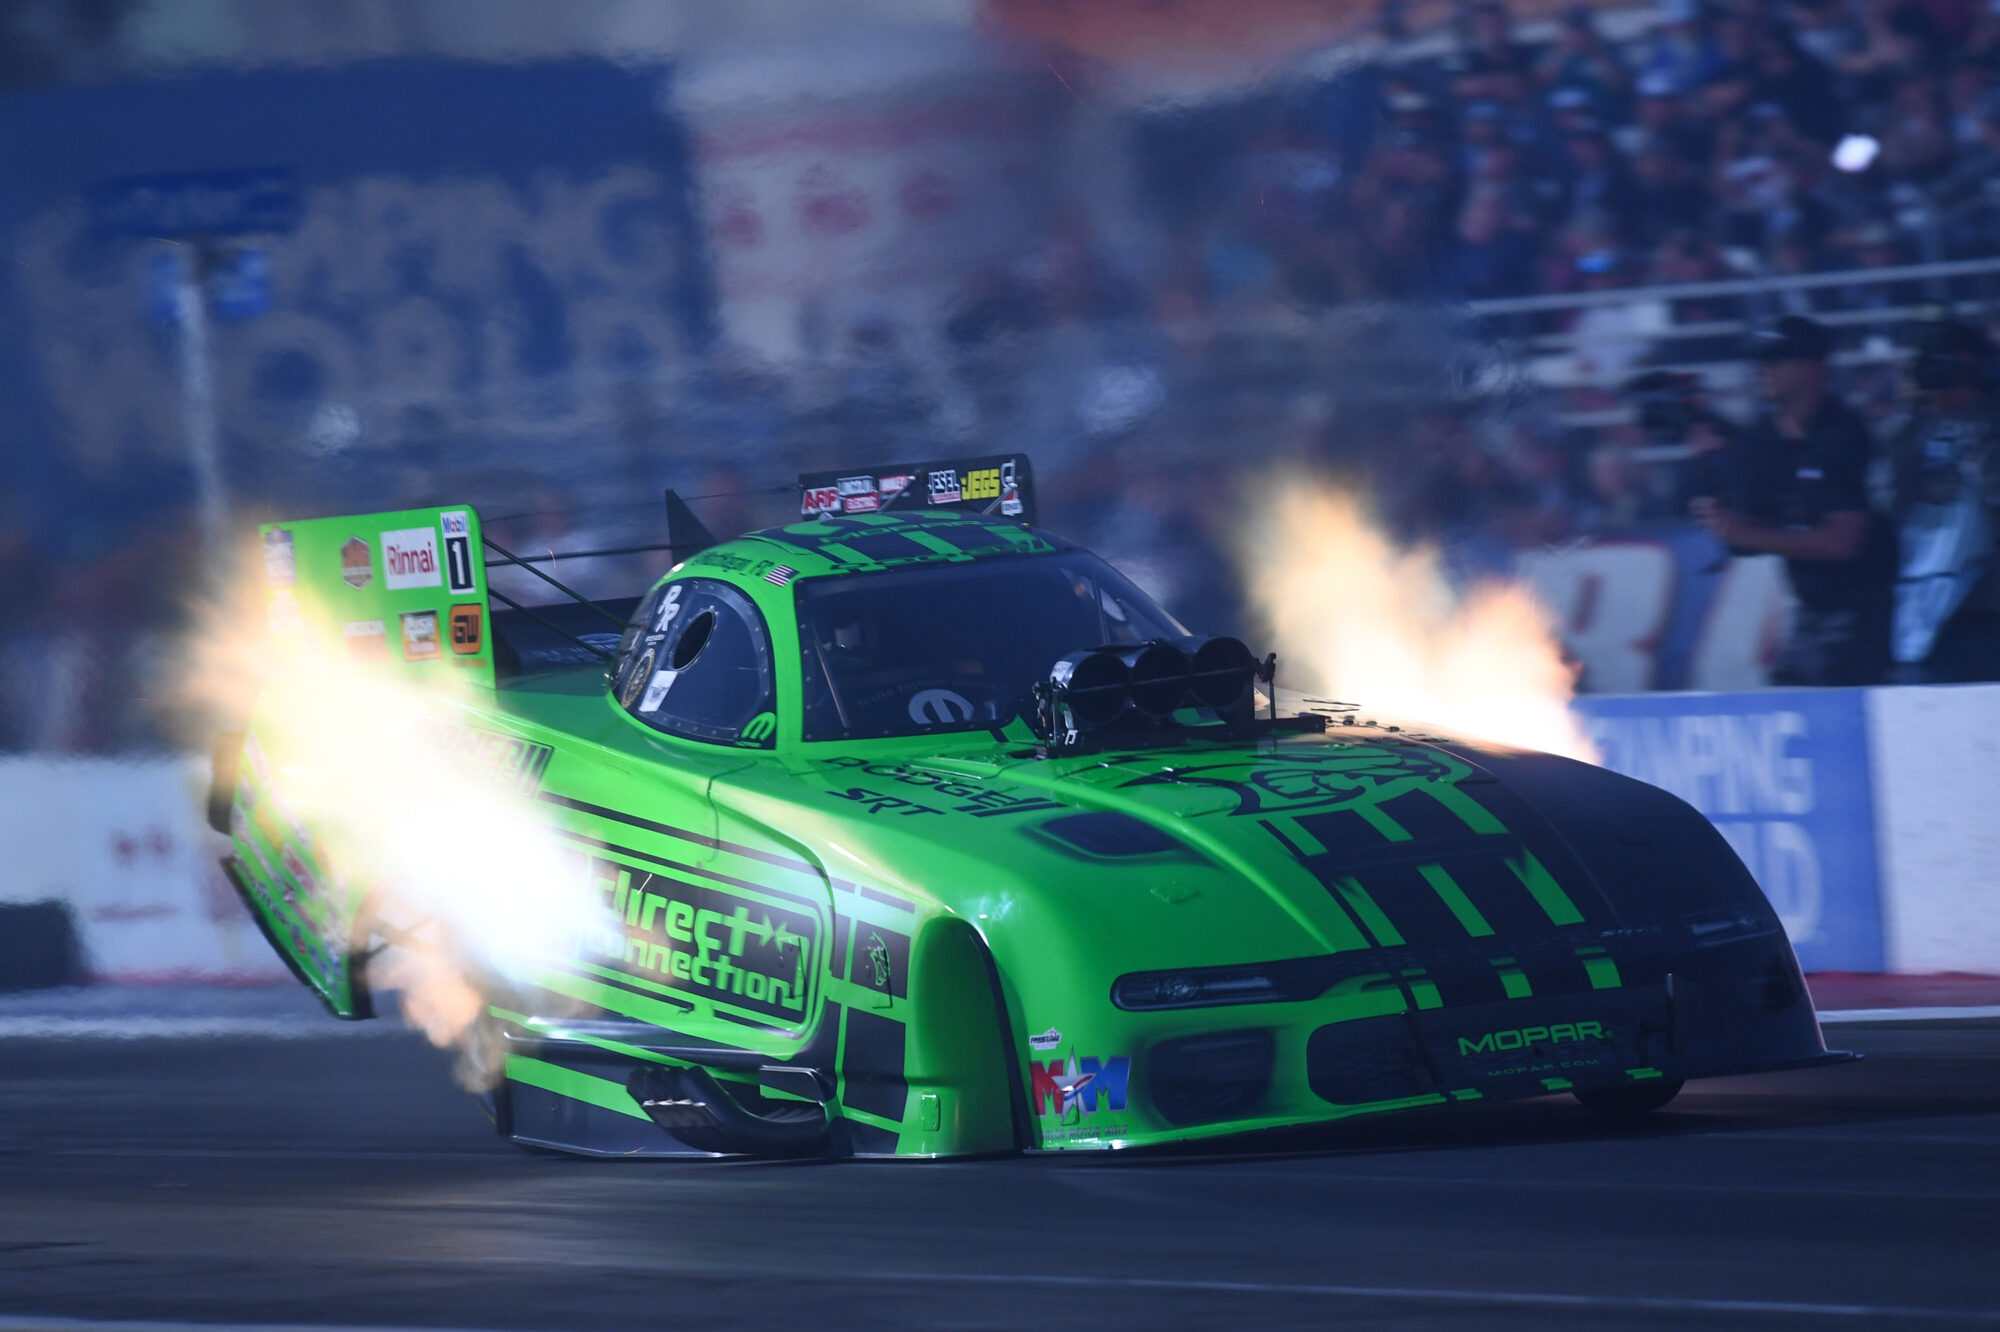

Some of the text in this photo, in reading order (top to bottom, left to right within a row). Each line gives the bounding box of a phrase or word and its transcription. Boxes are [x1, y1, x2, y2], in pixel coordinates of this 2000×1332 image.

[961, 468, 1000, 500] JEGS
[441, 516, 467, 534] Mobil
[386, 540, 435, 576] Rinnai
[451, 540, 466, 585] 1
[826, 787, 947, 816] SRT
[1456, 1020, 1605, 1057] MOPAR
